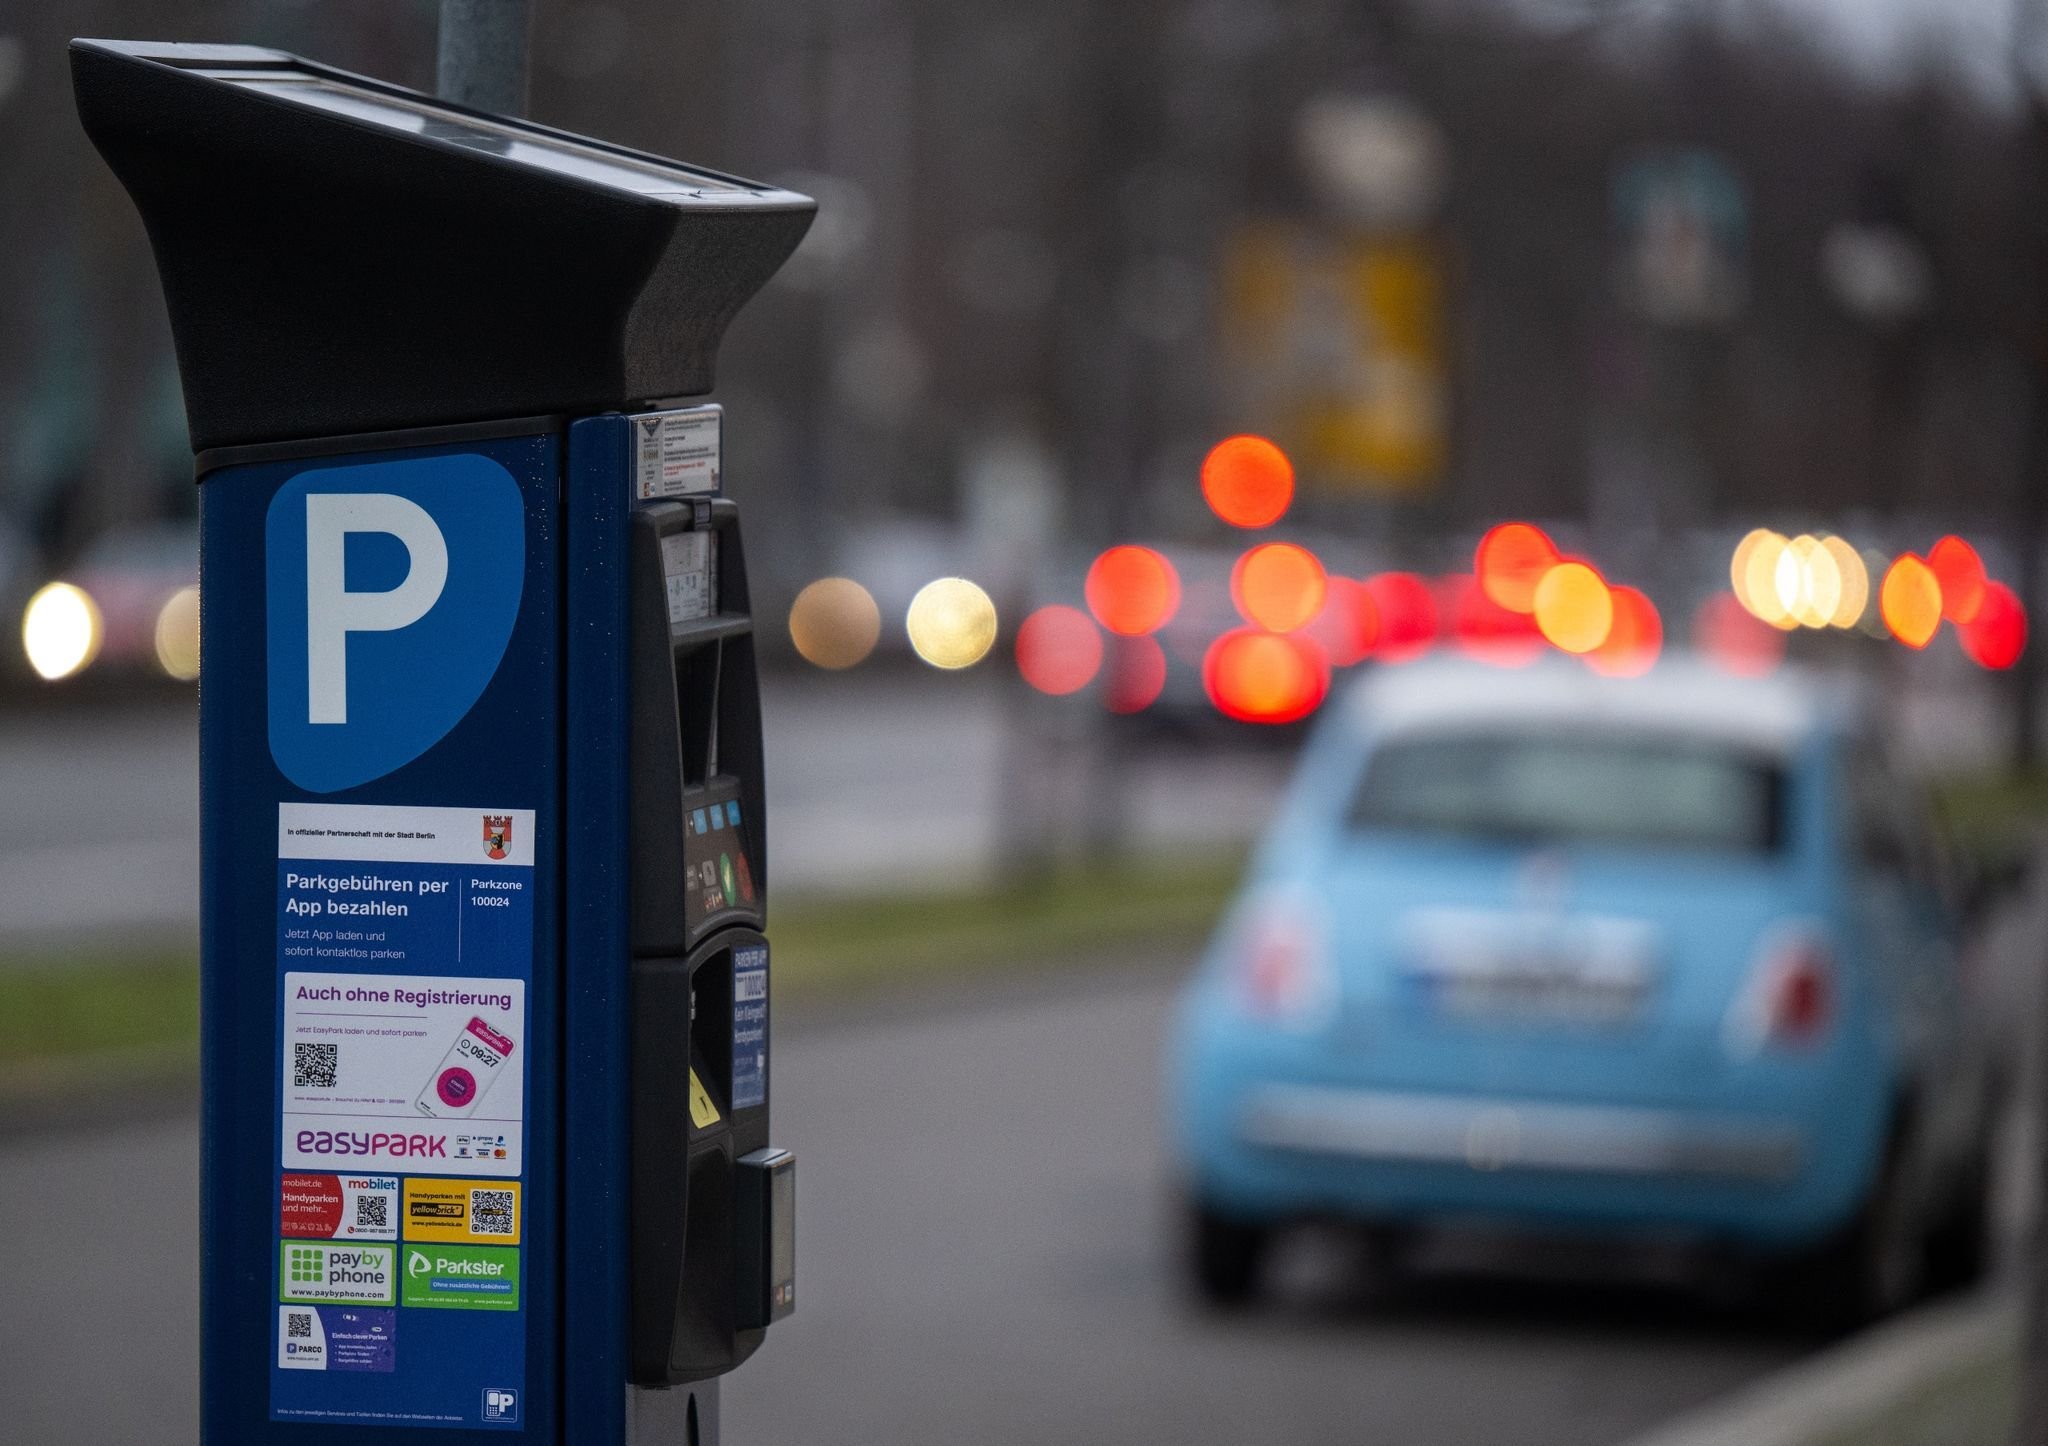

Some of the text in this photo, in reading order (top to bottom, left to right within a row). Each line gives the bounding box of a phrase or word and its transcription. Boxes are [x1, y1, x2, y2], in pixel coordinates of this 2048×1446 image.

[306, 492, 449, 725] P
[287, 828, 294, 836] In
[295, 828, 326, 836] offizieller
[327, 830, 371, 838] Partnerschaft
[384, 831, 395, 839] der
[416, 832, 436, 840] Berlin
[286, 874, 450, 895] Parkgebühren per
[471, 879, 523, 890] Parkzone
[286, 898, 408, 917] App bezahlen
[471, 897, 510, 908] 100024
[285, 929, 385, 942] Jetzt App laden und
[285, 947, 405, 961] sofort kontaktlos parken
[296, 986, 512, 1010] Auch ohne Registrierung
[296, 1026, 427, 1038] Jetzt EasyPark laden und sofort parken
[470, 1045, 499, 1068] 09:27
[283, 1179, 322, 1188] mobilet.de
[348, 1178, 396, 1190] mobilet
[283, 1193, 339, 1204] Handyparken
[410, 1192, 453, 1200] Handyparken
[283, 1204, 298, 1212] und
[412, 1206, 455, 1216] yellowbrick
[436, 1258, 504, 1276] Parkster
[329, 1268, 385, 1285] phone
[291, 1289, 385, 1298] www.paybyphone.com
[298, 1345, 322, 1353] PARCO
